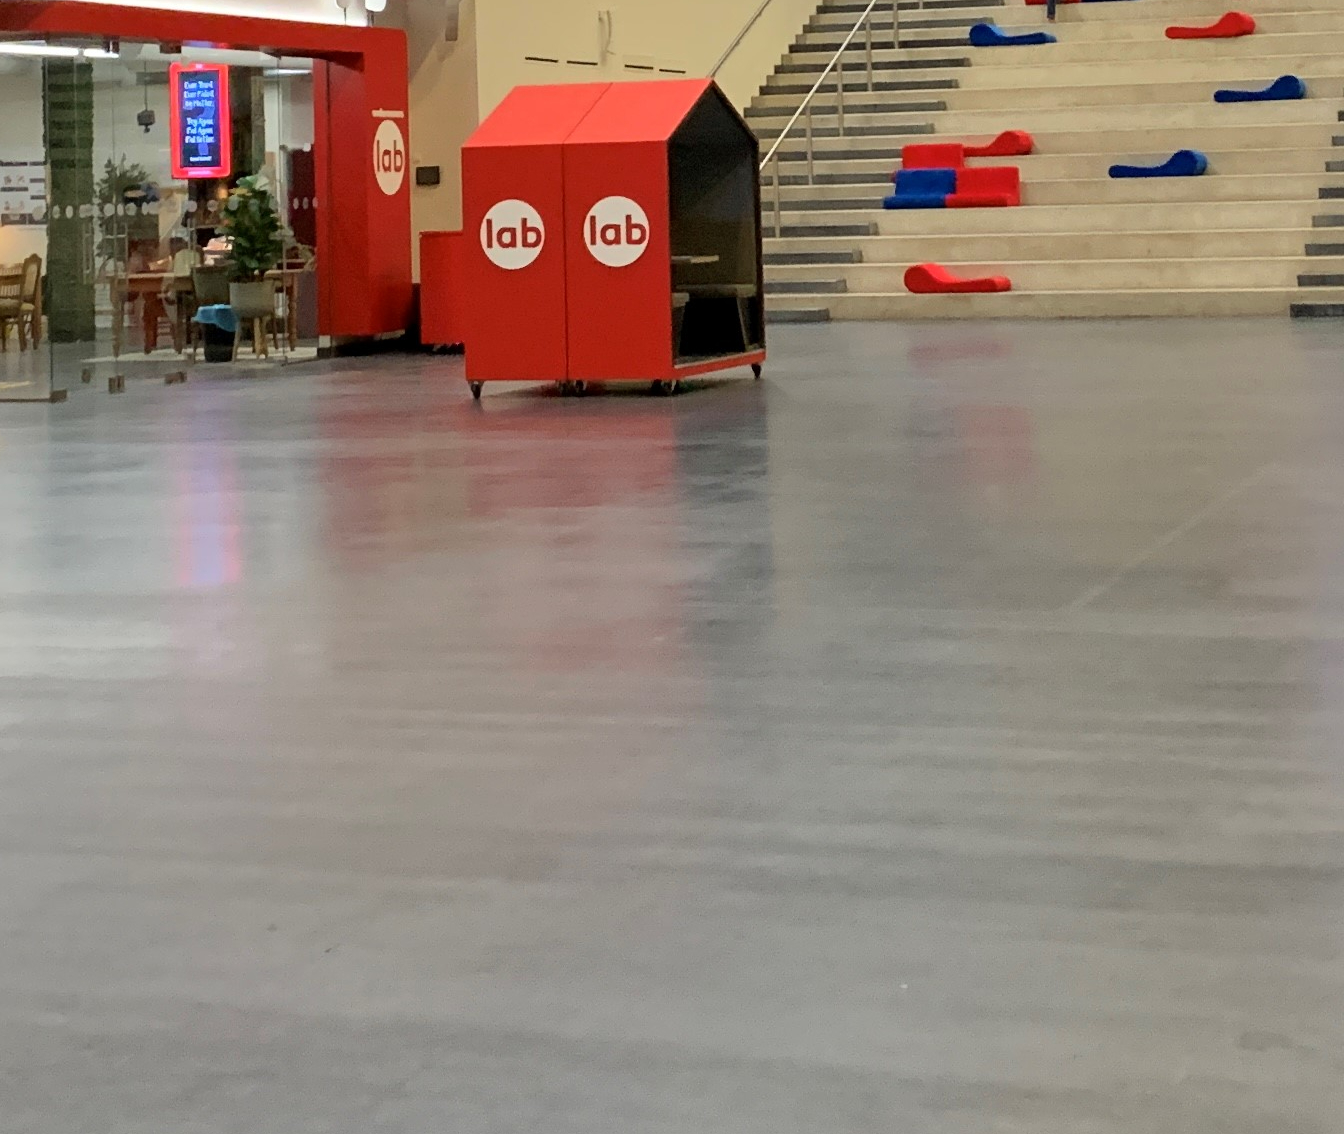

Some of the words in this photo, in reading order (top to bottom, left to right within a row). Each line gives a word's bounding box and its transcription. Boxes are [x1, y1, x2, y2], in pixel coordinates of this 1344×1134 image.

[376, 139, 404, 173] lab
[485, 217, 543, 249] lab
[589, 214, 647, 247] lab
